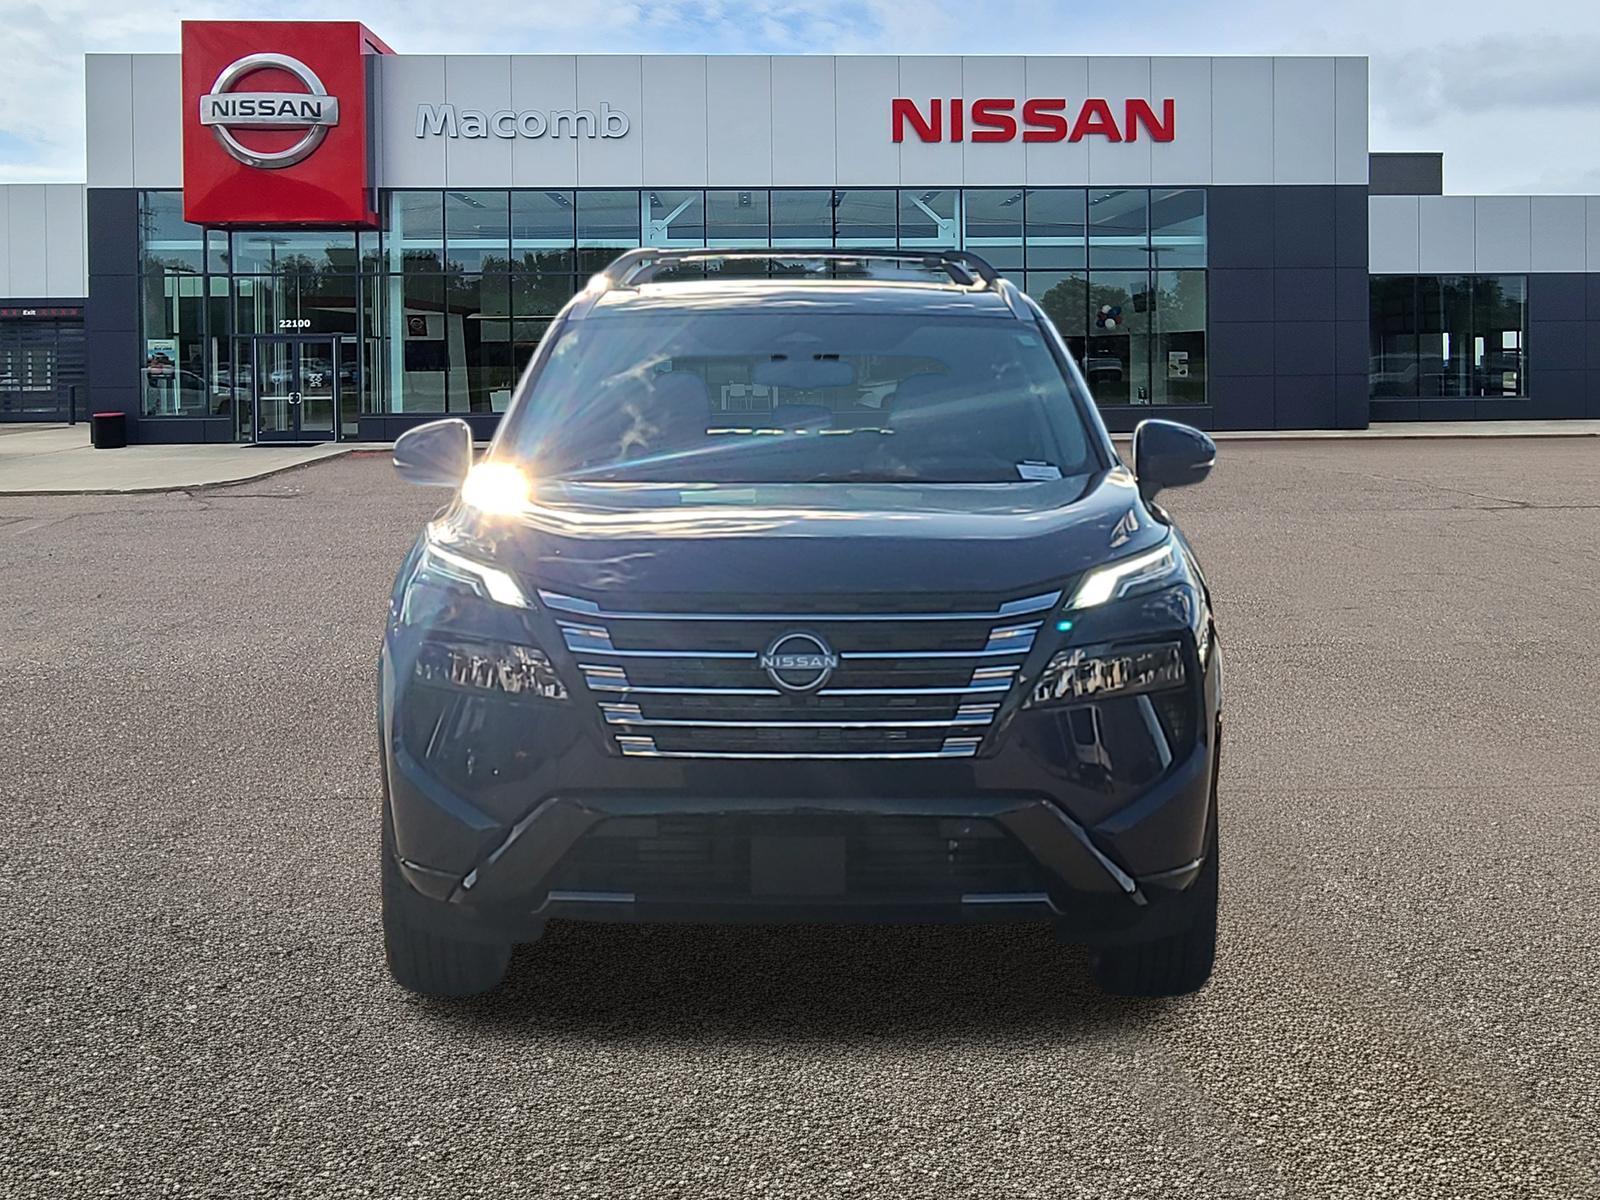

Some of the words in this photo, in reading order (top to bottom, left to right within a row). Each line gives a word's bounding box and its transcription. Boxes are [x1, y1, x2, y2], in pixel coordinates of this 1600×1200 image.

[212, 100, 322, 118] NISSAN
[415, 102, 630, 138] Macomb
[891, 98, 1176, 143] NISSAN
[279, 319, 311, 328] 22100
[760, 656, 838, 668] NISSAN
